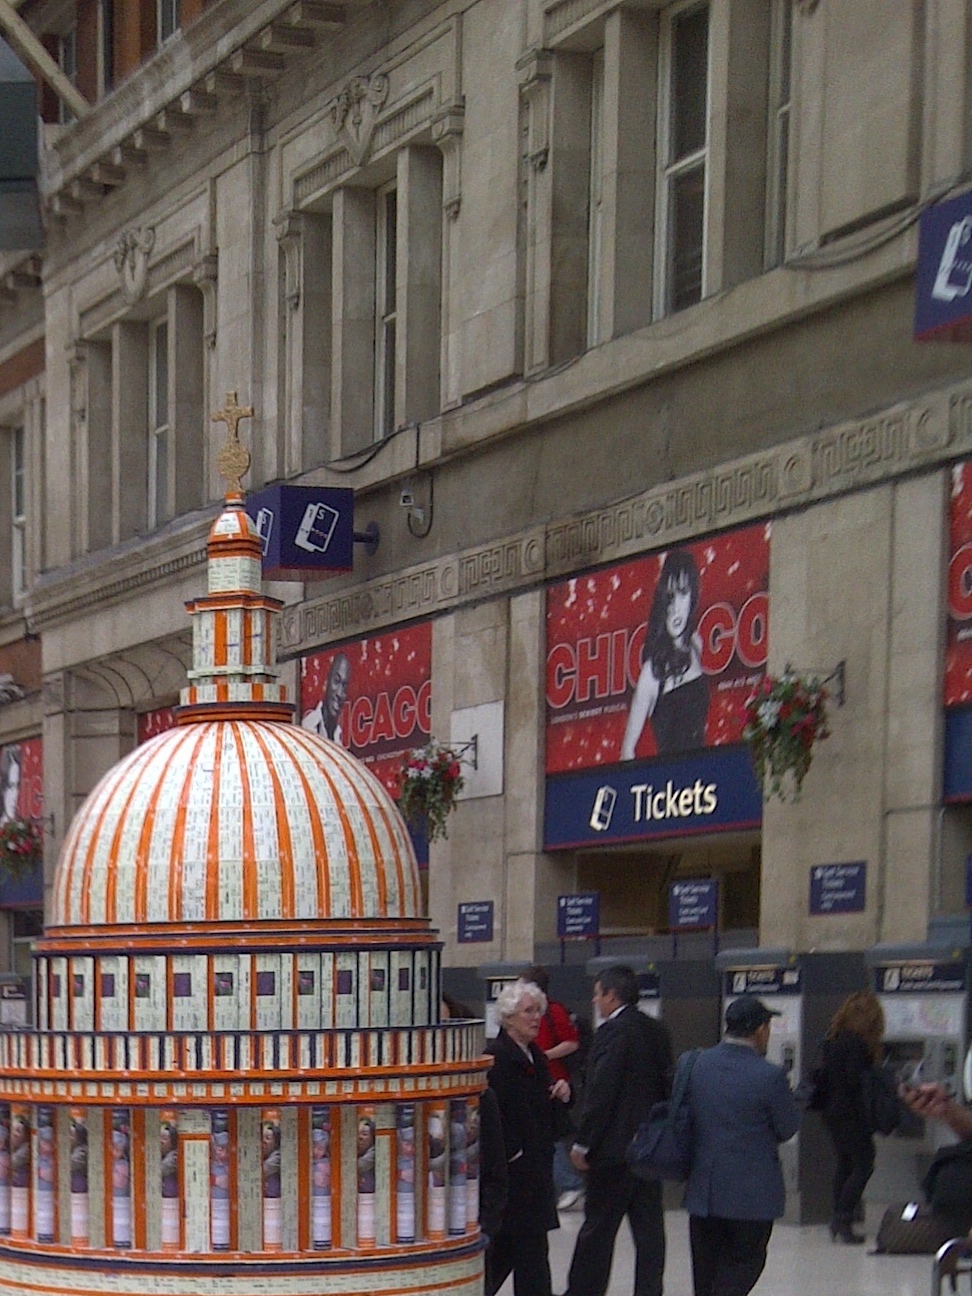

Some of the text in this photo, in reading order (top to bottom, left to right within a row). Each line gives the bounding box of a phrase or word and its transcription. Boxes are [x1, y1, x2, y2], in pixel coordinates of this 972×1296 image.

[546, 591, 770, 709] CHIGO
[304, 679, 432, 748] ICAGO
[630, 778, 717, 822] Tickets
